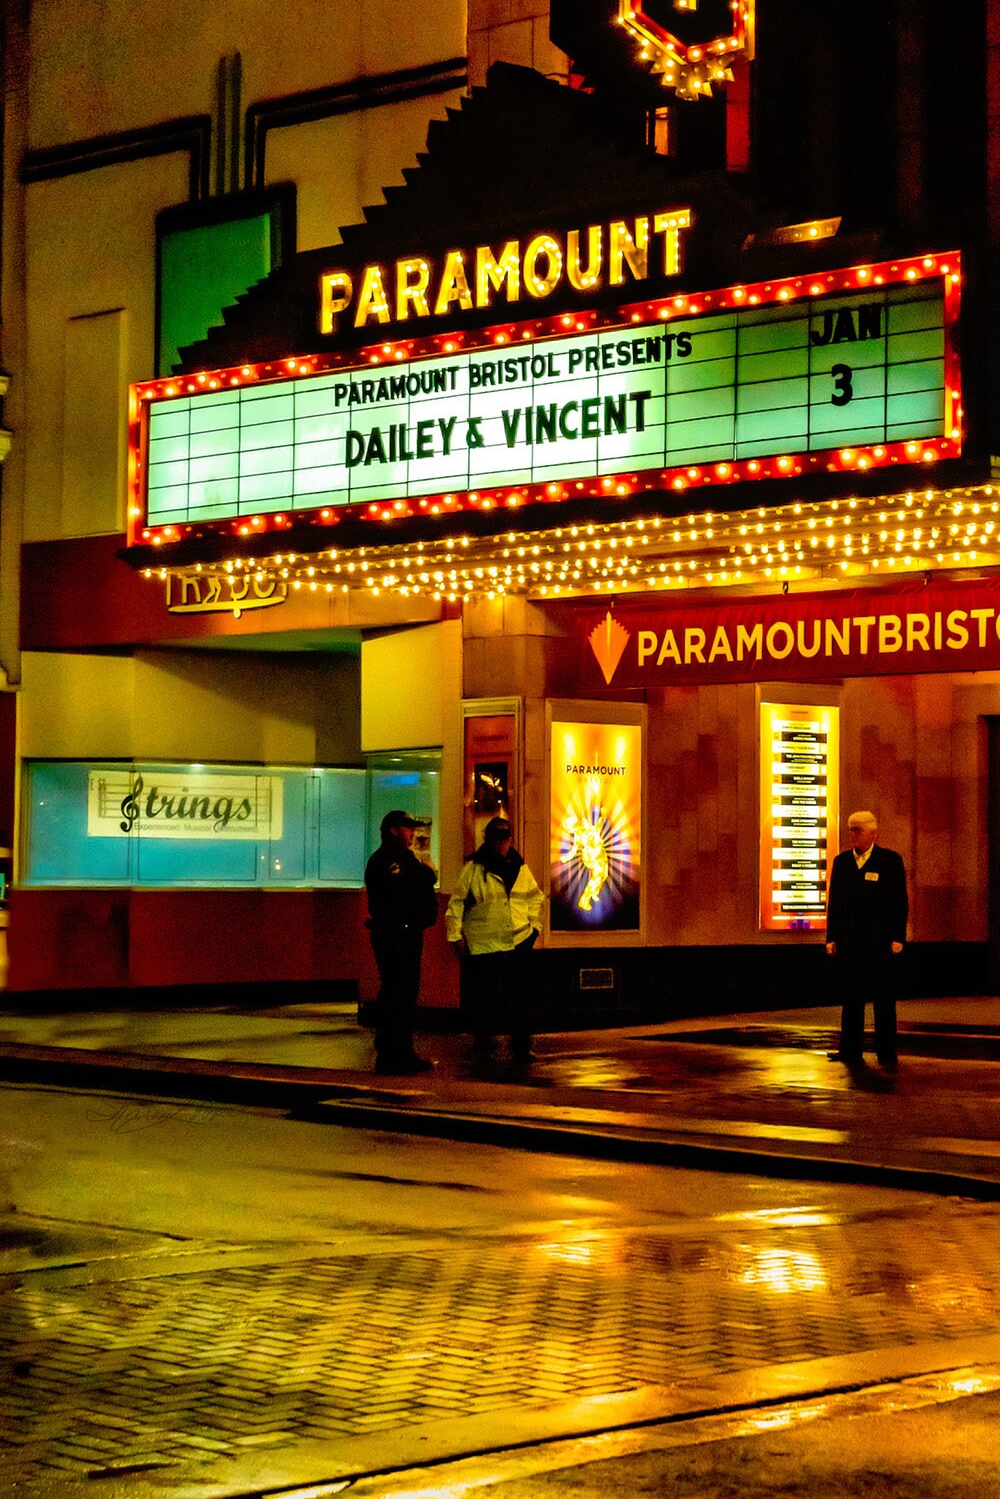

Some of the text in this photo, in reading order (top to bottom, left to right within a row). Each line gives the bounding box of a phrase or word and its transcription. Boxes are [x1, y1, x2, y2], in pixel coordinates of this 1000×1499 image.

[319, 208, 691, 334] PARAMOUNT
[810, 304, 882, 347] JAN
[333, 333, 693, 407] PARAMOUNT BRISTOL PRESENTS
[830, 364, 853, 408] 3
[344, 389, 652, 470] DAILEY & VINCENT
[566, 764, 626, 776] PARAMOUNT
